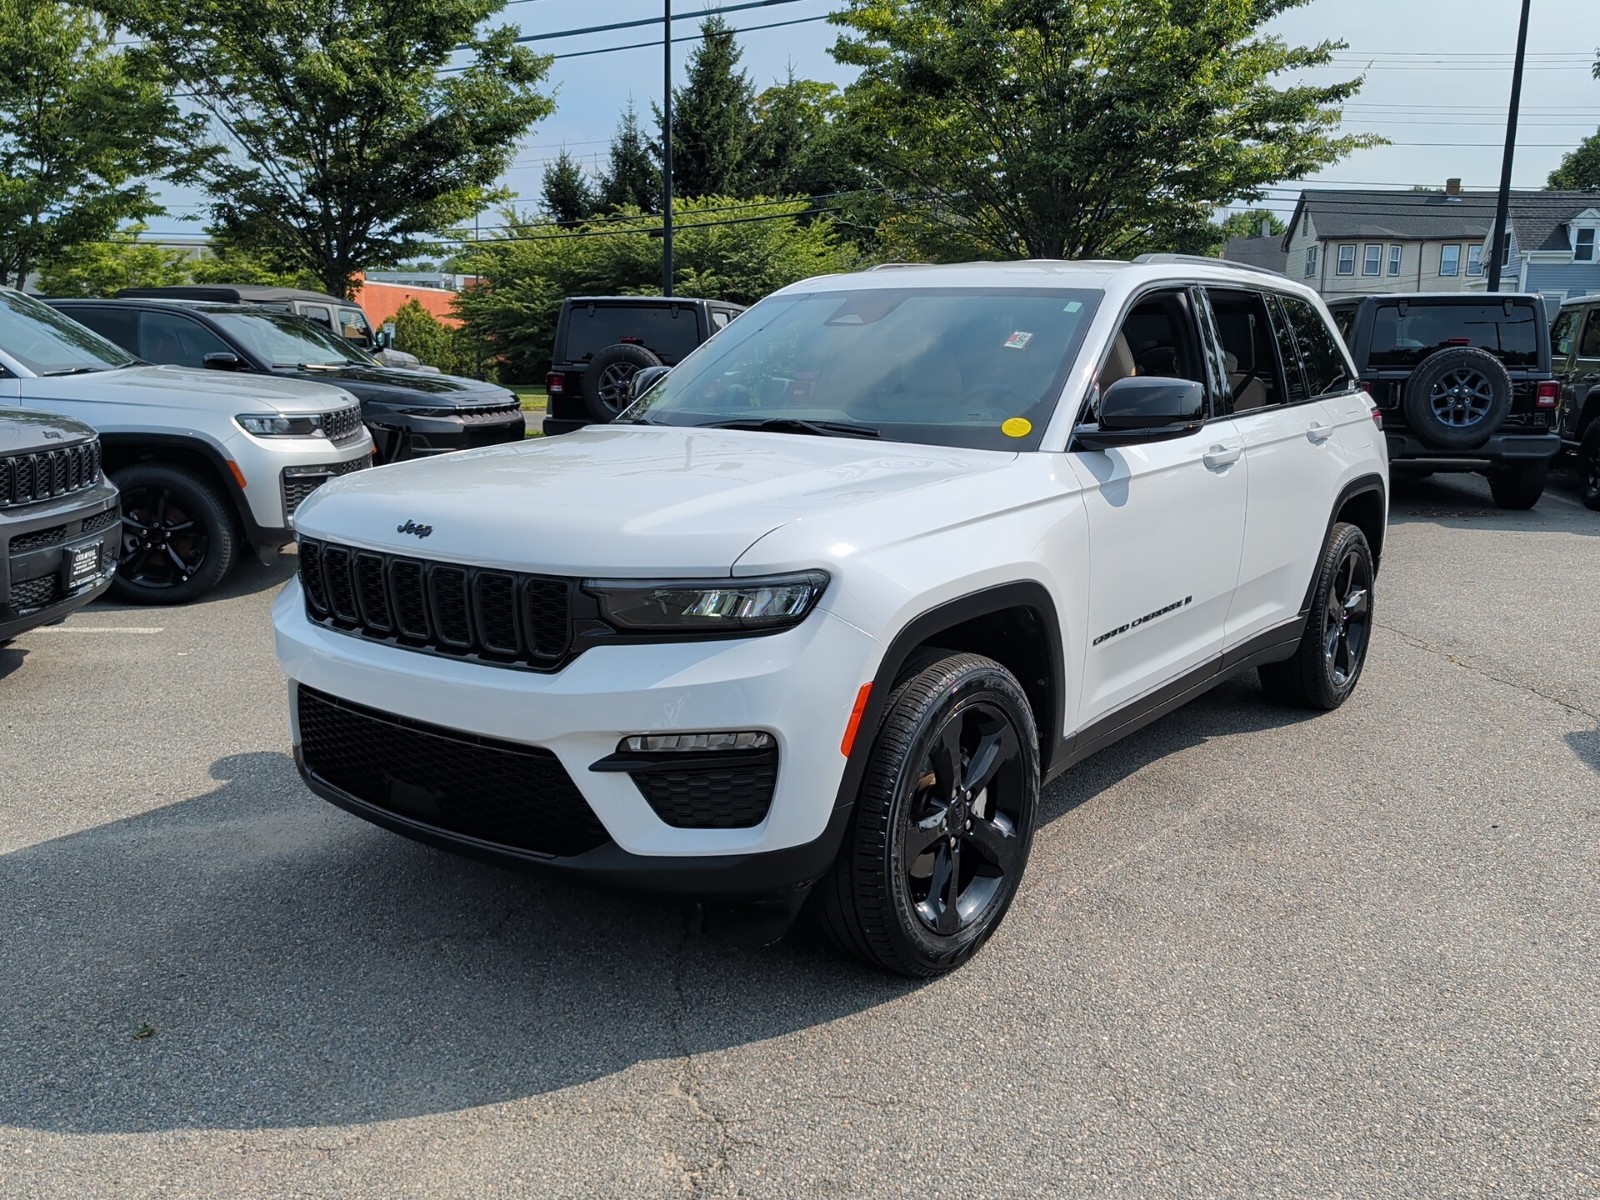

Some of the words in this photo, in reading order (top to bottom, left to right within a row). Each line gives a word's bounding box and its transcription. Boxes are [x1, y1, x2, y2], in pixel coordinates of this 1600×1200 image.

[397, 519, 433, 539] Jeep
[1092, 623, 1130, 647] GRAND
[1130, 599, 1184, 629] CHEROKEE
